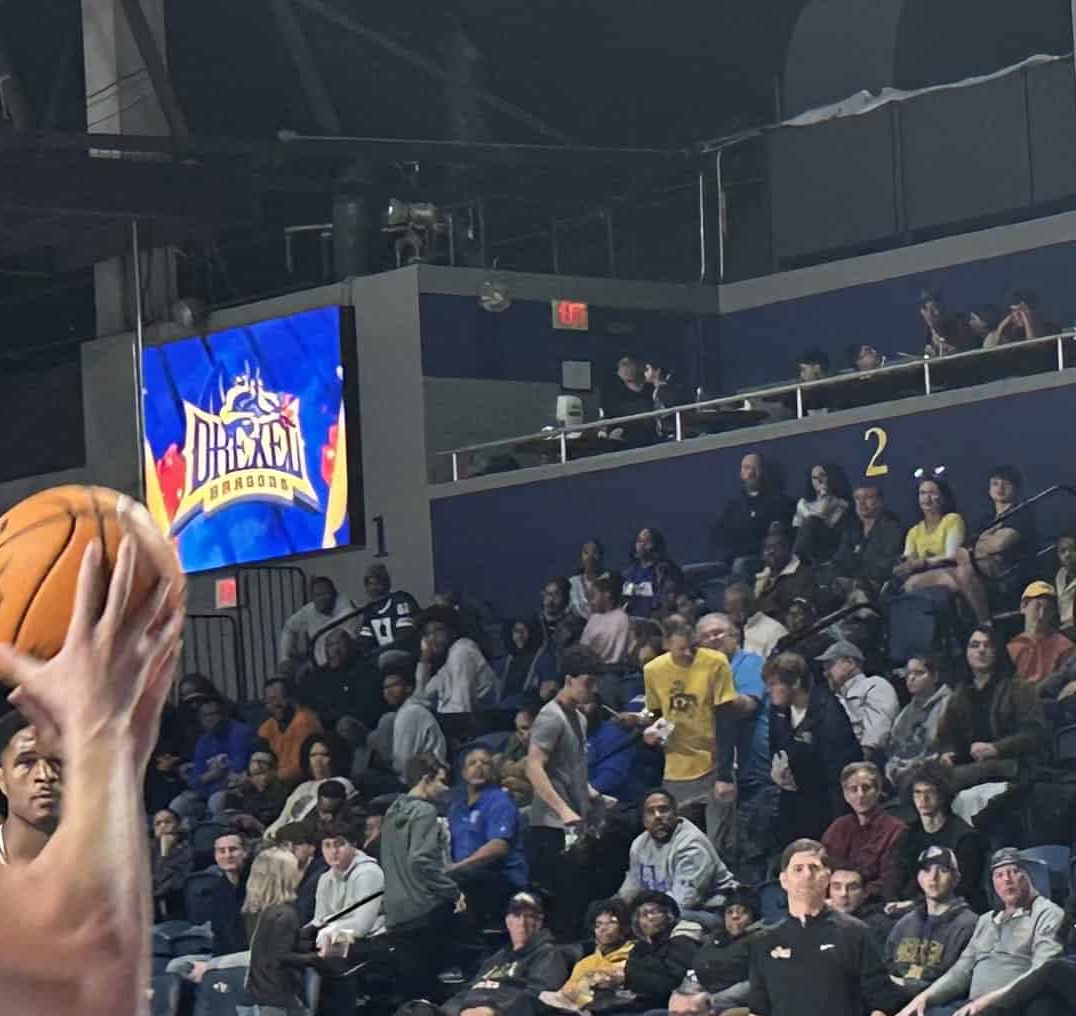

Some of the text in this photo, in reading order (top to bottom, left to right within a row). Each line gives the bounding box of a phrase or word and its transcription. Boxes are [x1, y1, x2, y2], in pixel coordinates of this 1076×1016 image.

[192, 412, 303, 492] DREXEL
[864, 426, 888, 477] 2
[372, 514, 388, 558] 1
